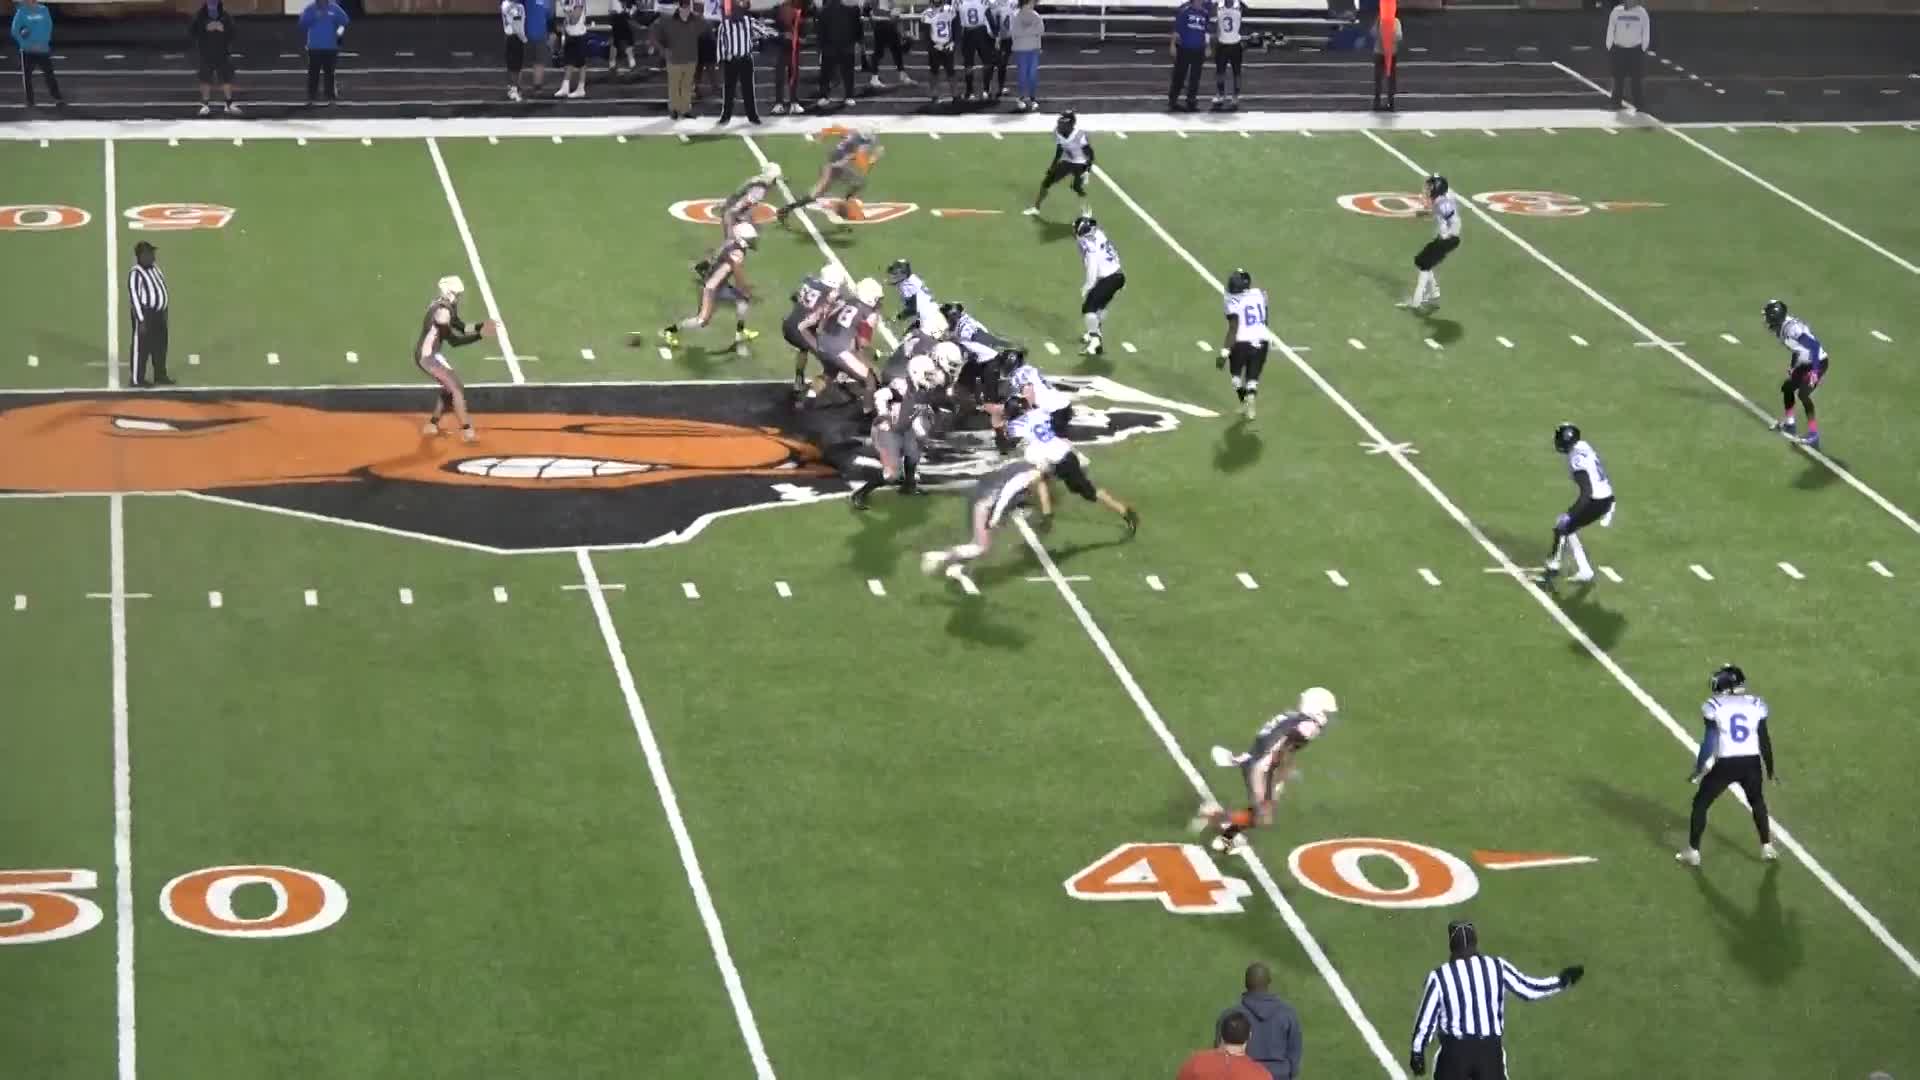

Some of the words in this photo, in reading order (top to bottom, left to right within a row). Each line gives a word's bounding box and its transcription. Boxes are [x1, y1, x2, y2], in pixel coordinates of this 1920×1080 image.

[967, 8, 979, 25] 8
[1223, 16, 1234, 32] 3
[1729, 713, 1750, 743] 6
